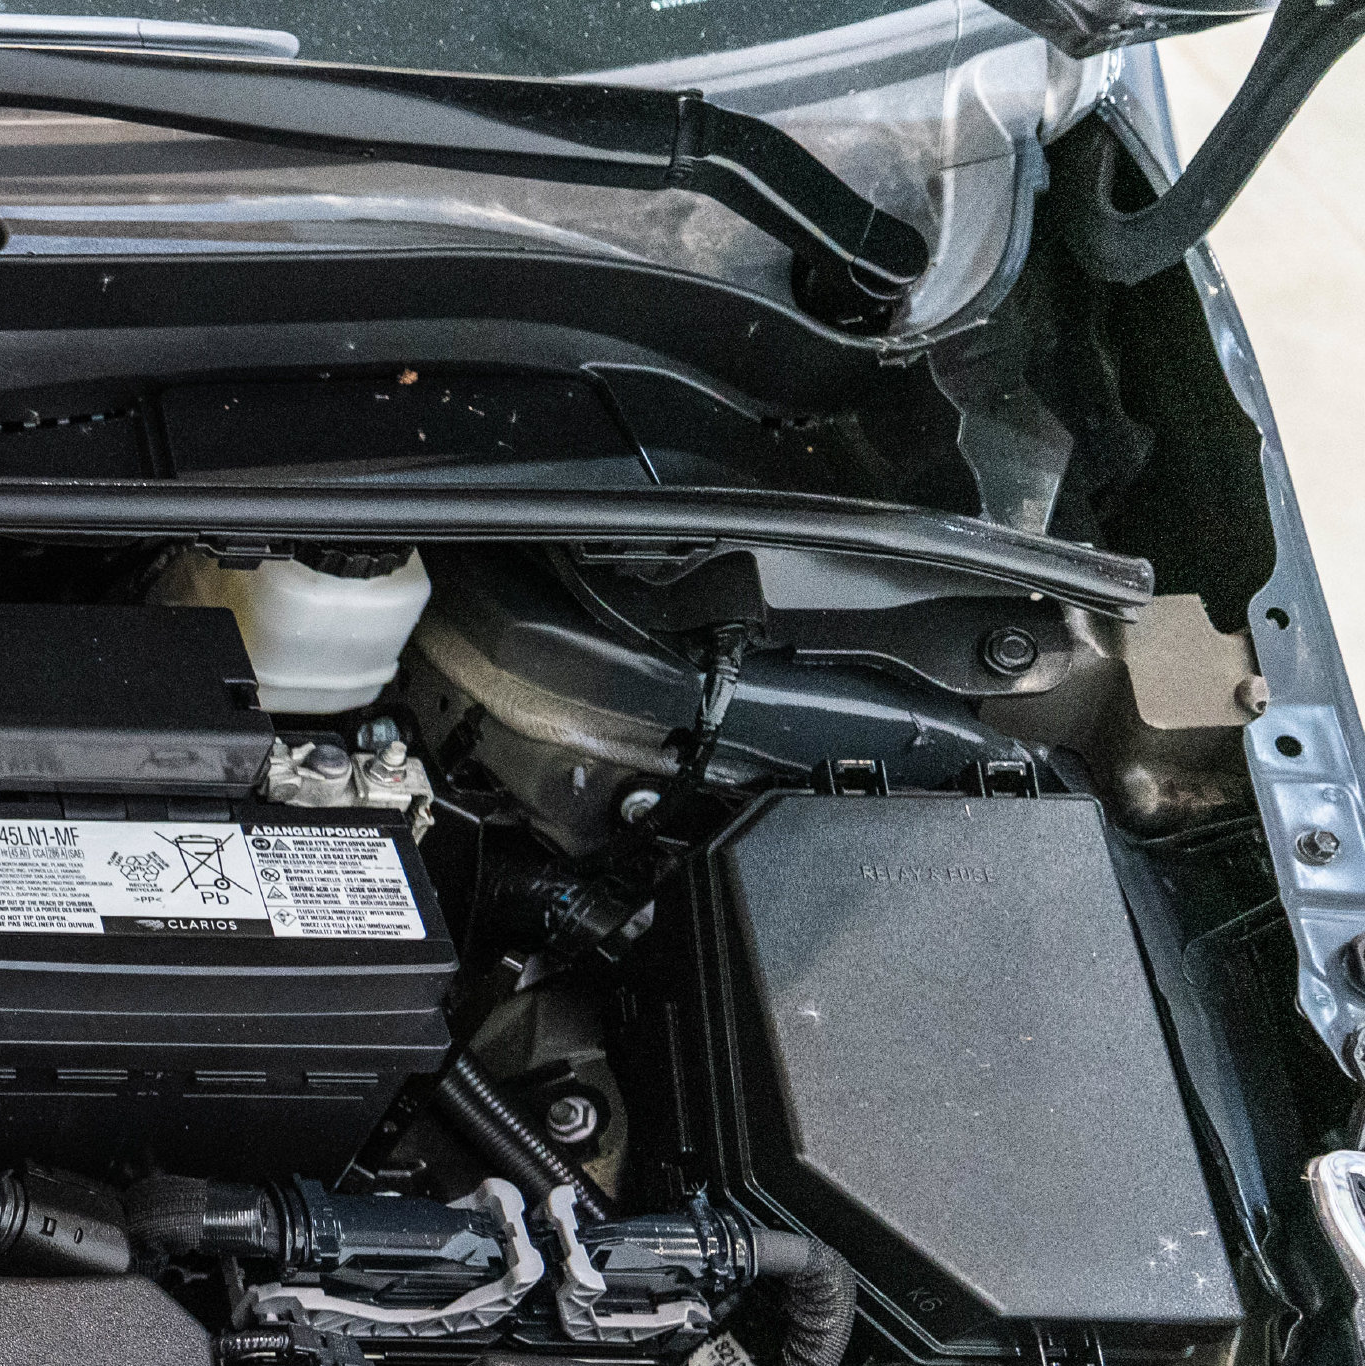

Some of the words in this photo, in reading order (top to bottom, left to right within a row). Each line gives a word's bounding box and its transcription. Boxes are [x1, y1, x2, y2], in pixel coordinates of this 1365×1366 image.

[262, 826, 380, 837] DANGER/POISON
[861, 866, 920, 881] RELAY
[946, 867, 996, 882] FUSE
[200, 891, 229, 905] Pb
[167, 919, 237, 930] CLARIOS
